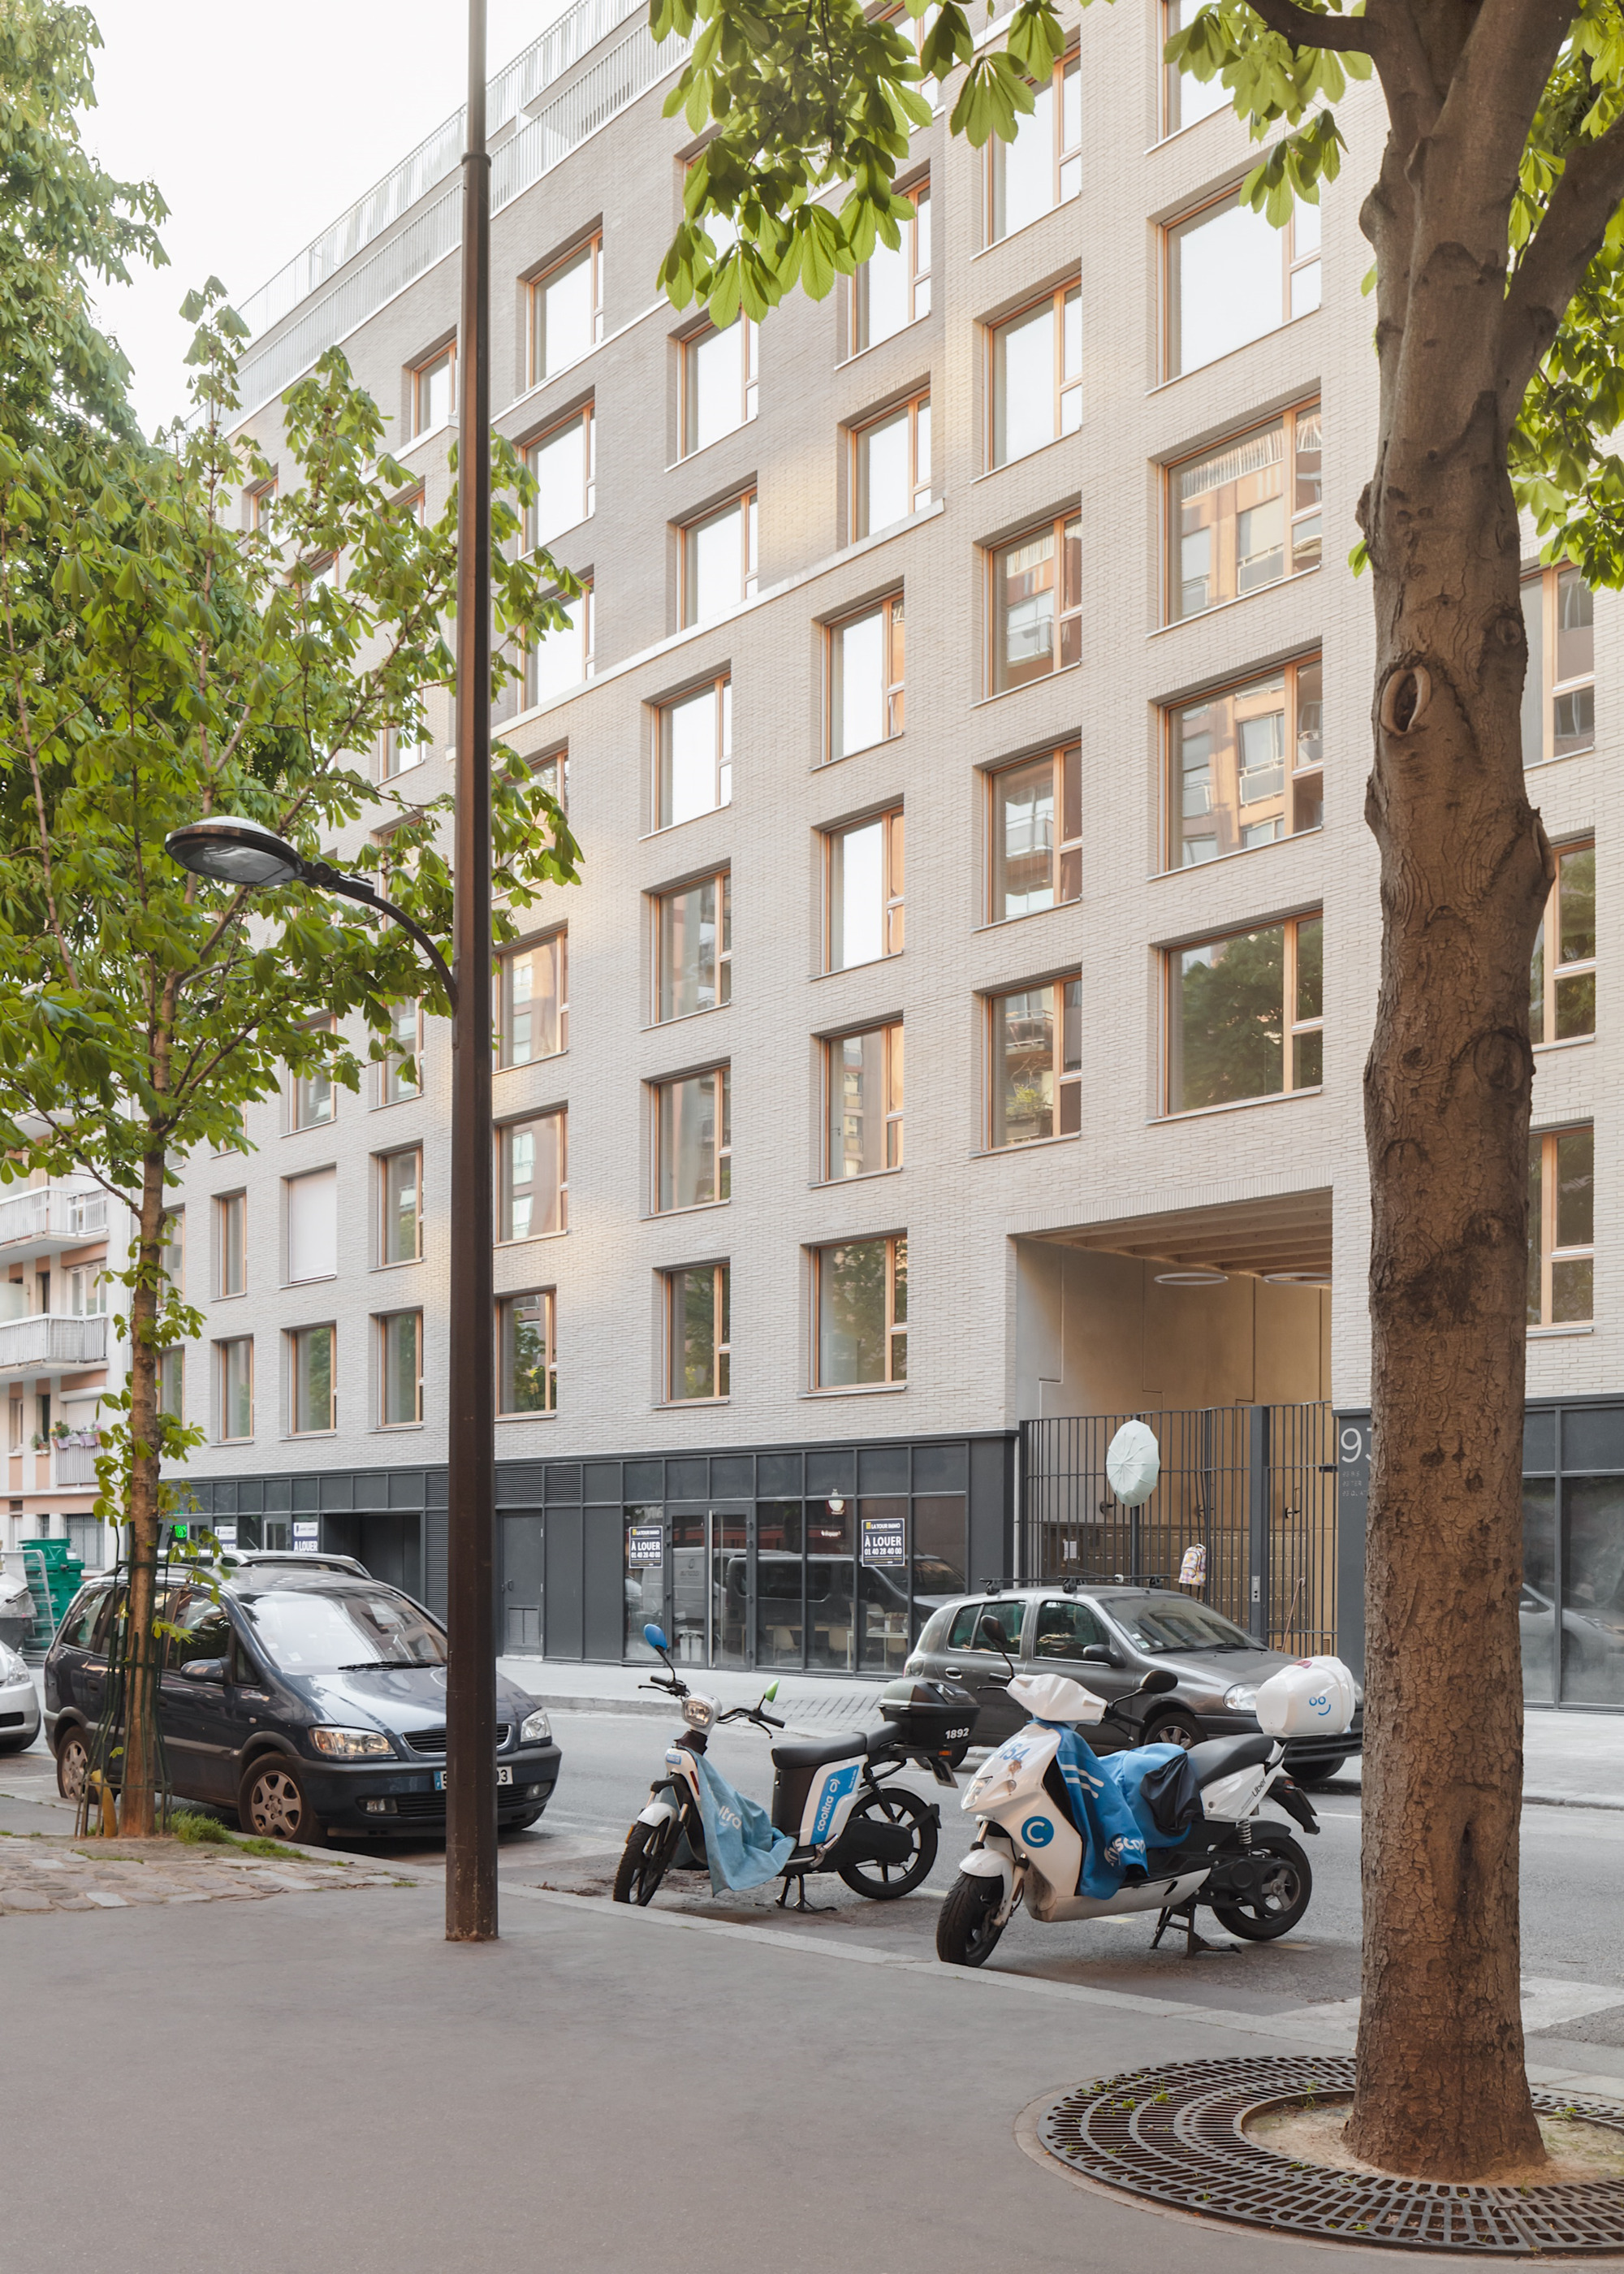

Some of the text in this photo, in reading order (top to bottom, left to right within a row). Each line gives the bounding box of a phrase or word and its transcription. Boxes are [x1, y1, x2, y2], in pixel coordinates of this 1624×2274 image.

[299, 1541, 318, 1551] LOUER
[637, 1541, 661, 1550] LOUER
[865, 1535, 902, 1547] À LOUER
[945, 1727, 970, 1740] 1892
[1251, 1778, 1267, 1797] Uber
[719, 1805, 742, 1830] ltra
[817, 1796, 834, 1832] cooltra
